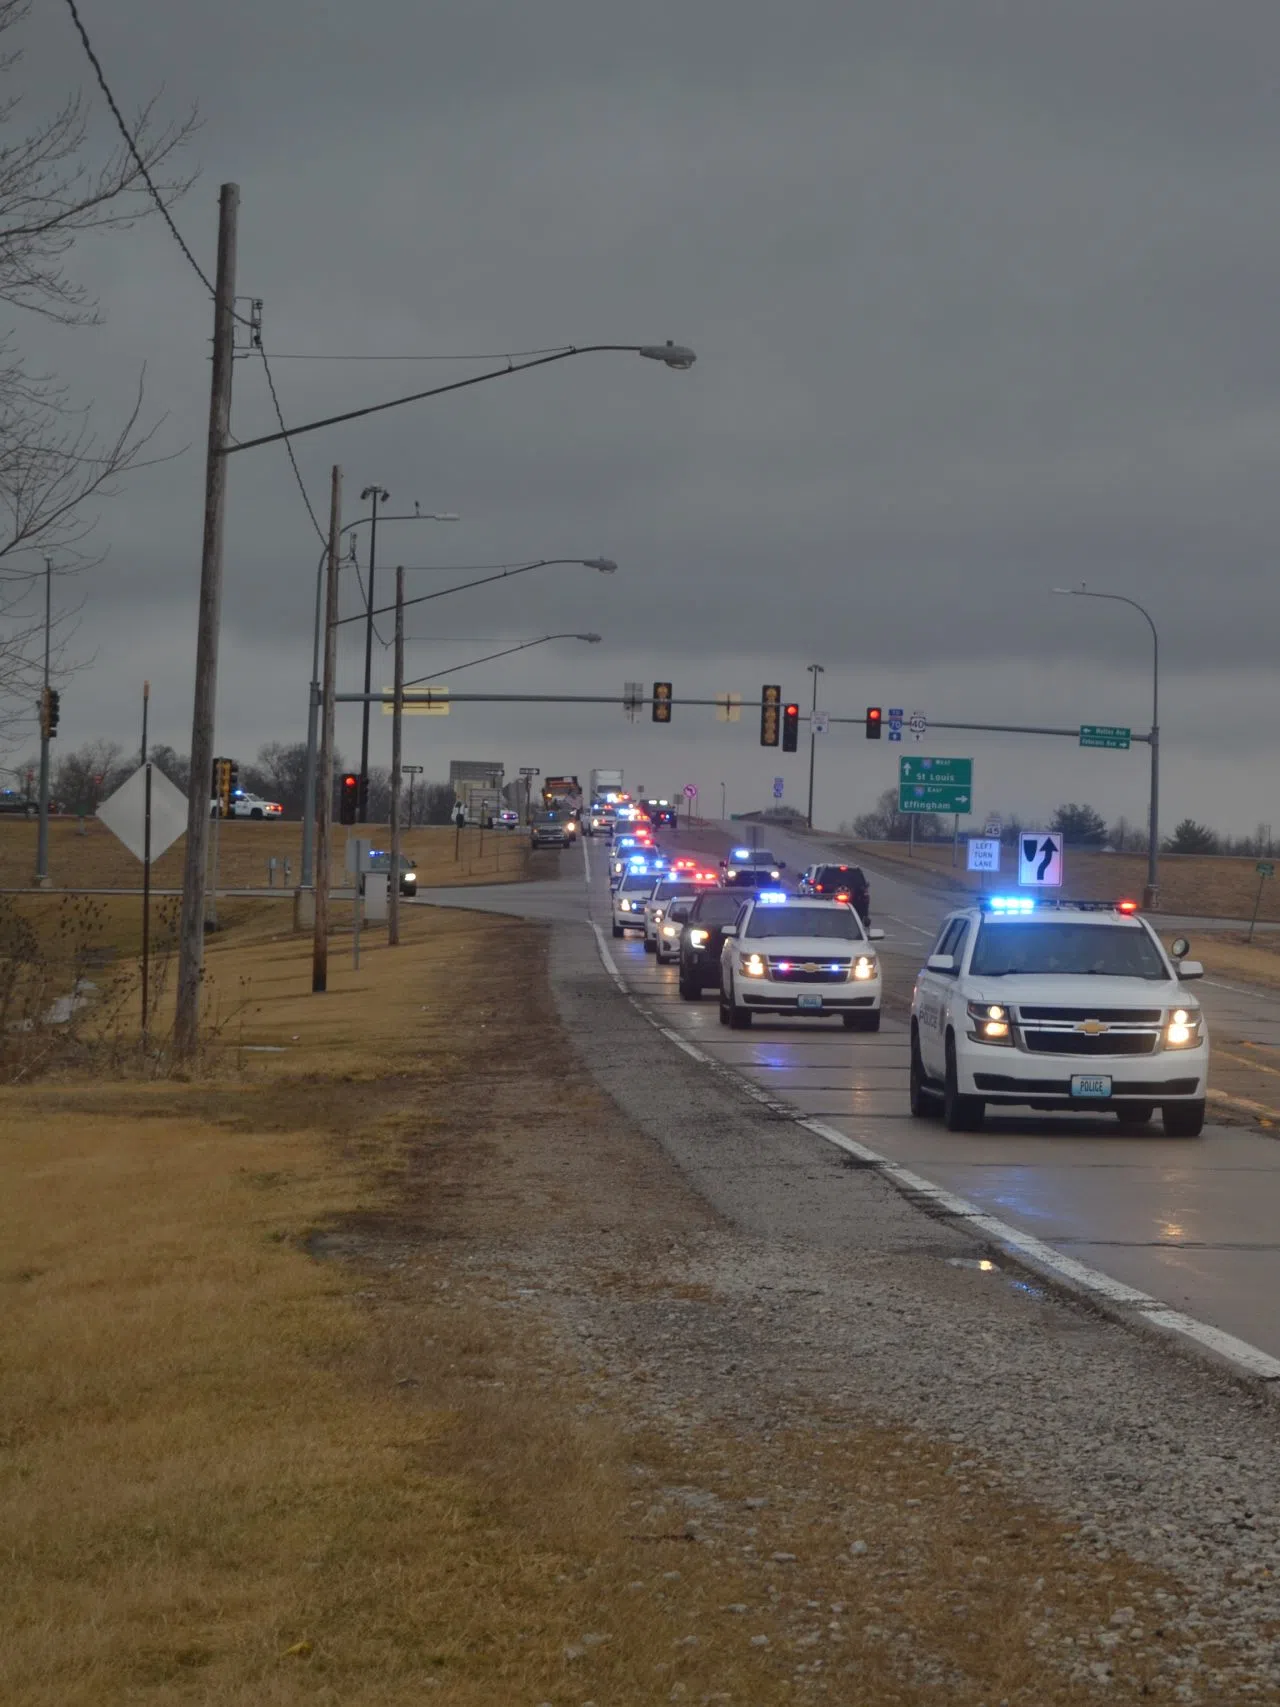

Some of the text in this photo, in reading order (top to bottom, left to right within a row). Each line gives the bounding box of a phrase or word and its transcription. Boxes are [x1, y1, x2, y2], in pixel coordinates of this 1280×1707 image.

[912, 720, 924, 729] 40
[916, 773, 955, 781] St Louis
[903, 800, 951, 810] Effingham
[986, 827, 998, 835] 45
[1080, 1080, 1104, 1092] POLICE
